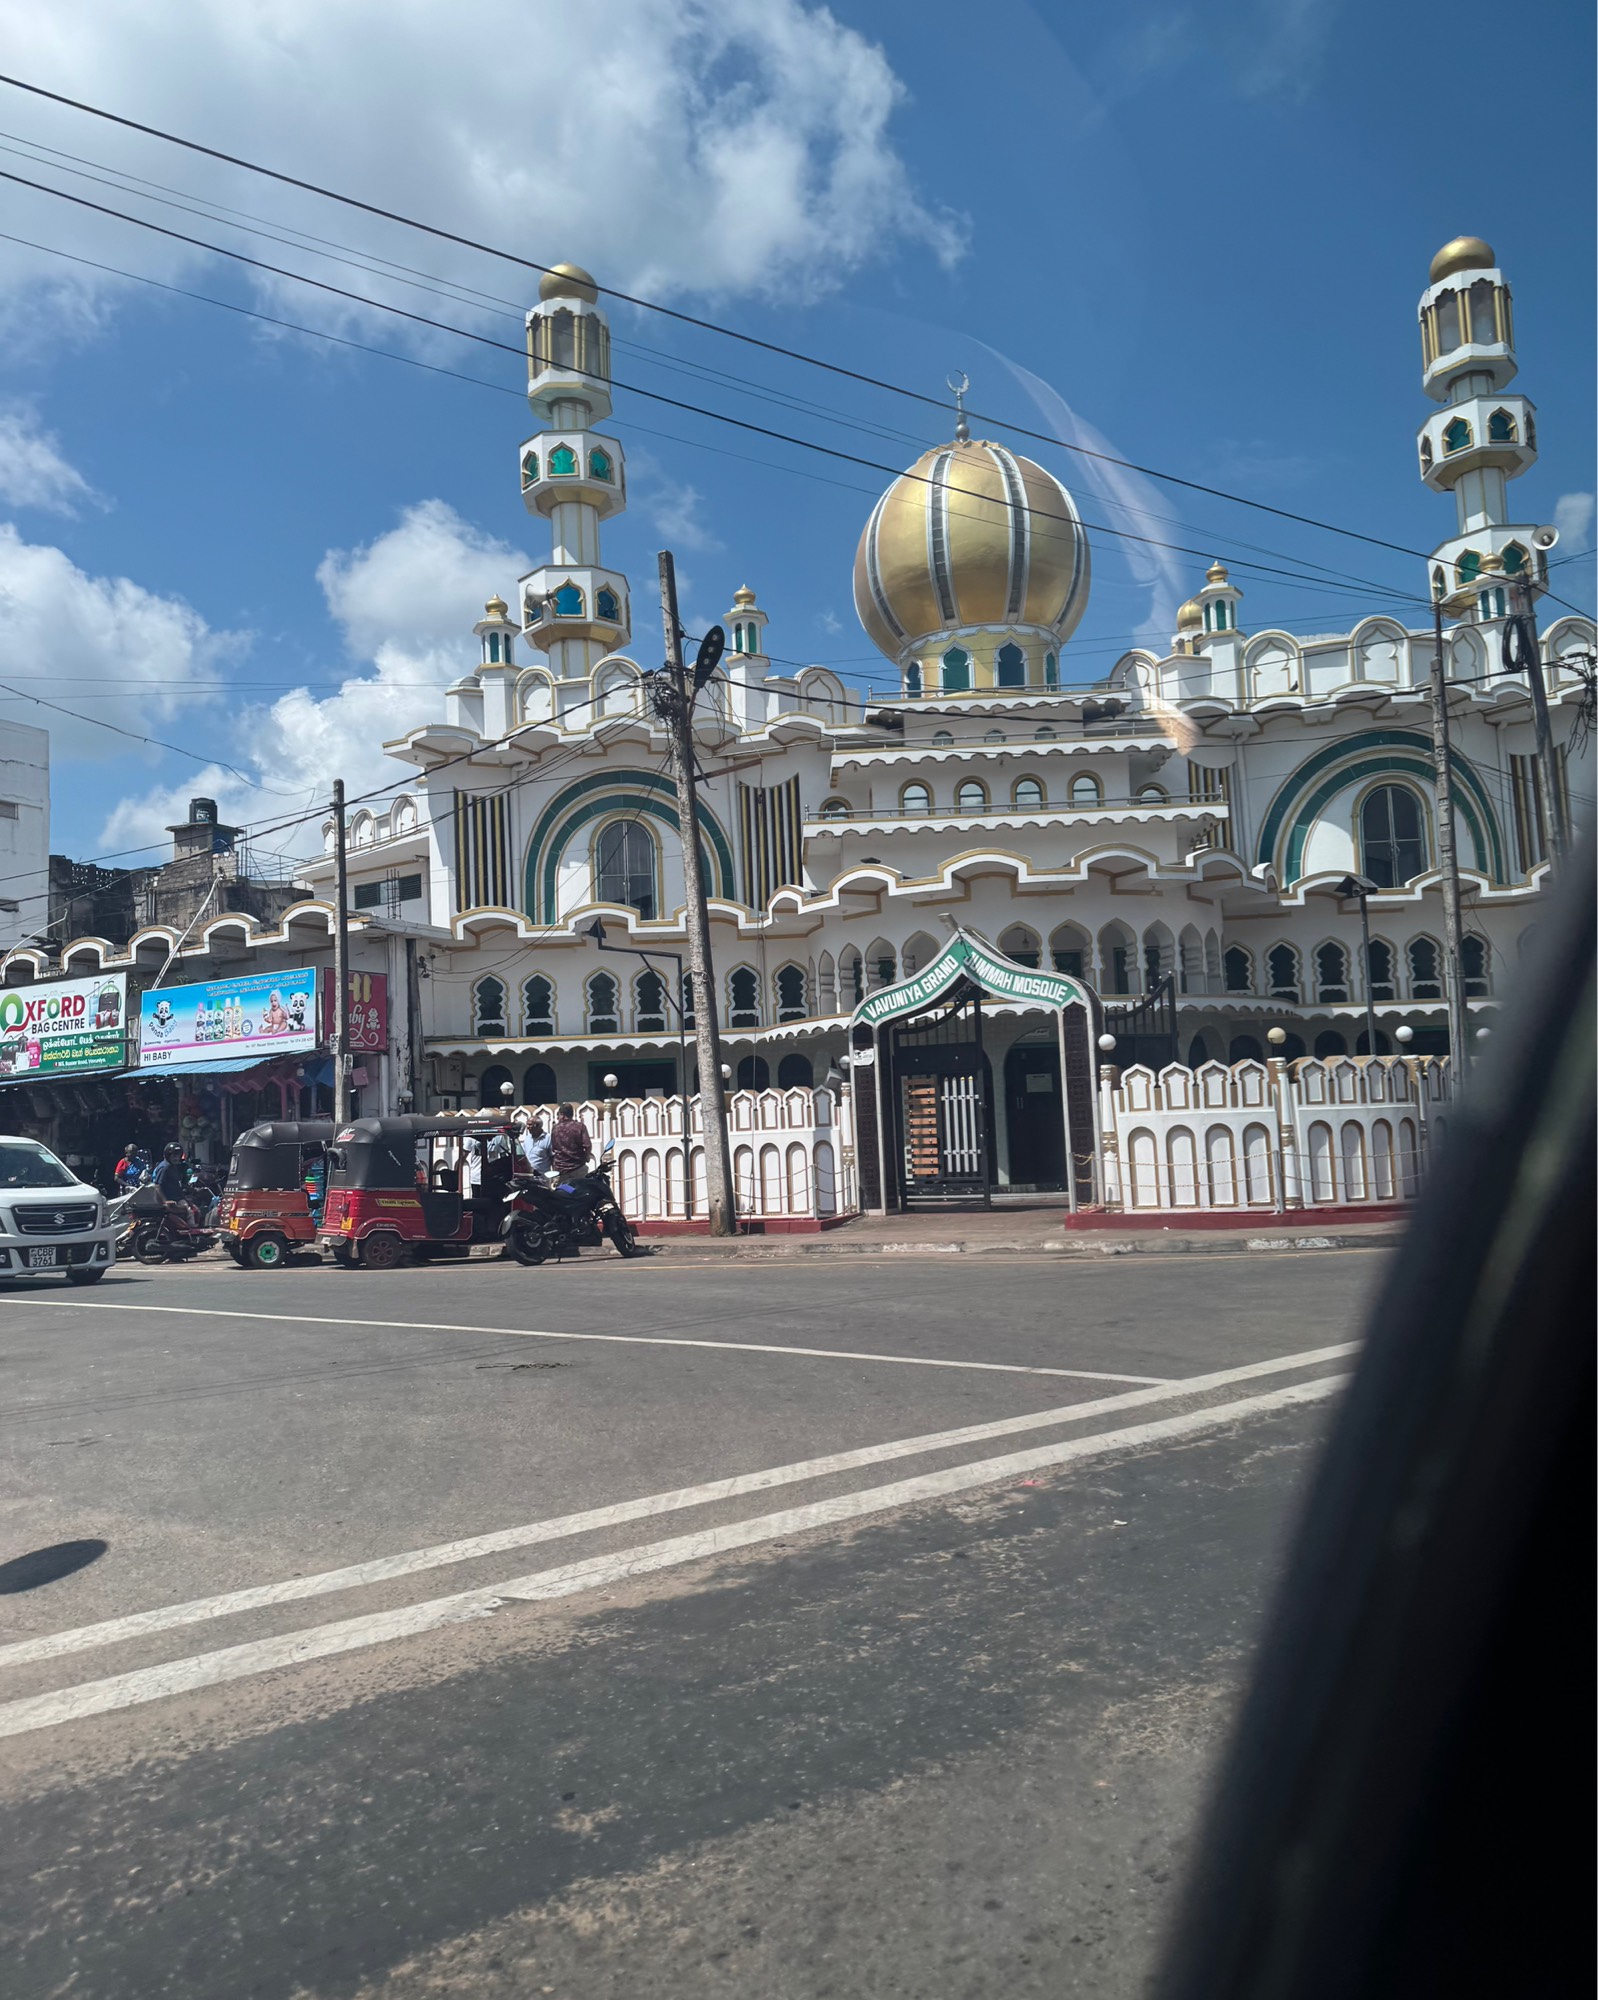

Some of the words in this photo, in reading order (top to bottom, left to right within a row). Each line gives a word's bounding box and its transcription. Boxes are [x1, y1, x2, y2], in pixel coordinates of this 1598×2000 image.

[865, 984, 924, 1019] VAVUNIYA
[921, 954, 959, 994] GRAND
[963, 951, 1014, 990] JUMMAH
[1012, 975, 1068, 1003] MOSQUE
[0, 993, 86, 1038] OXFORD
[31, 1022, 50, 1035] BAG
[51, 1017, 85, 1032] CENTRE
[144, 1053, 151, 1061] HI
[152, 1051, 172, 1061] BABY
[32, 1256, 53, 1267] 3761
